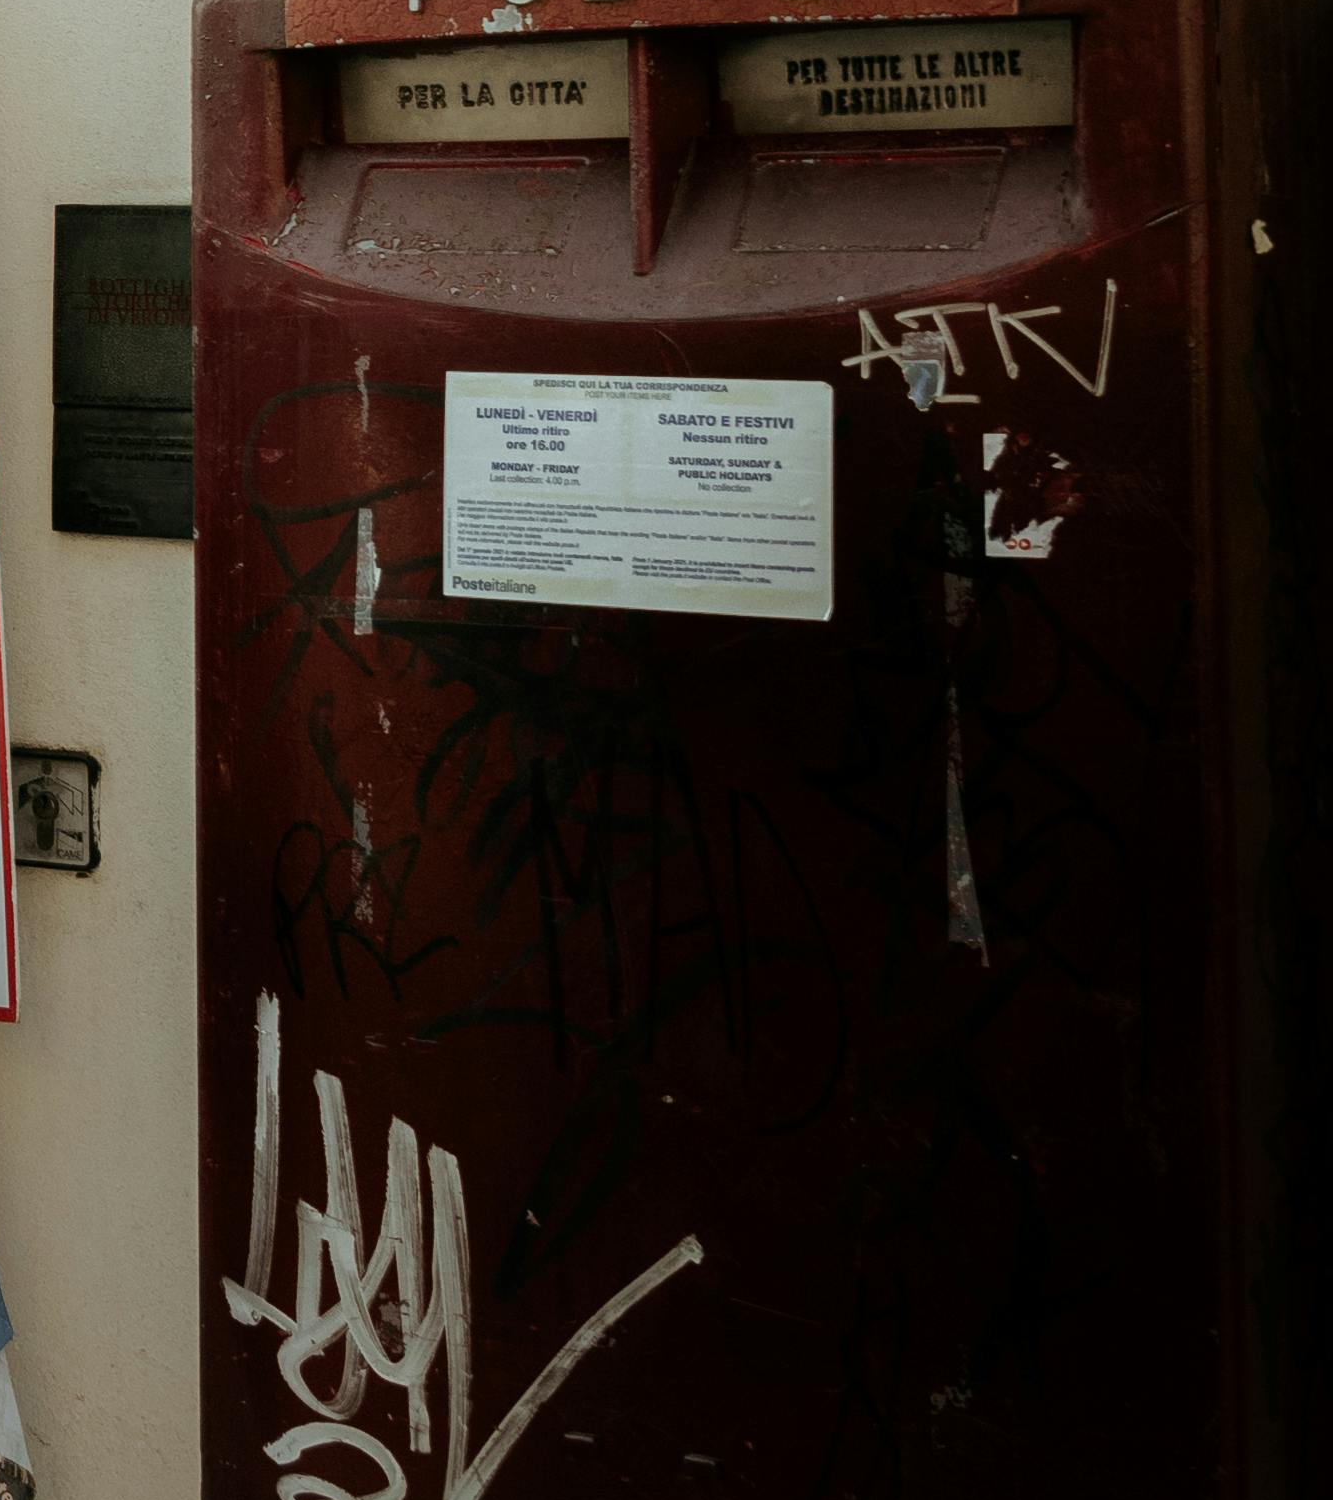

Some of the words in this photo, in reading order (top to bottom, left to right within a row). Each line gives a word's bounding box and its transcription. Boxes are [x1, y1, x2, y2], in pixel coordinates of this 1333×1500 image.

[787, 58, 826, 84] PER
[837, 55, 902, 82] TUTTE
[915, 53, 939, 79] LE
[954, 50, 1022, 77] ALTRE
[398, 83, 446, 109] PER
[461, 83, 494, 106] LA
[820, 84, 986, 116] DESTINAZIONI
[534, 379, 576, 388] SPEDISCI
[579, 381, 595, 389] QUI
[599, 381, 610, 389] LA
[614, 382, 632, 390] TUA
[636, 383, 728, 392] CORRISPONDENZA
[476, 406, 525, 420] LUNEDÌ
[537, 409, 597, 422] VENERDÌ
[658, 414, 716, 427] SABATO
[722, 416, 730, 427] E
[735, 416, 794, 429] FESTIVI
[502, 424, 538, 435] Ultimo
[542, 425, 570, 436] ritiro
[683, 432, 731, 443] Nessun
[735, 434, 768, 445] ritiro
[507, 441, 526, 449] ore
[531, 440, 565, 451] 16.00
[491, 462, 534, 471] MONDAY
[543, 464, 579, 474] FRIDAY
[668, 457, 724, 469] SATURDAY,
[728, 458, 770, 468] SUNDAY
[774, 461, 782, 469] &
[678, 470, 716, 479] PUBLIC
[719, 472, 772, 482] HOLIDAYS
[453, 576, 536, 593] Posteitaliane
